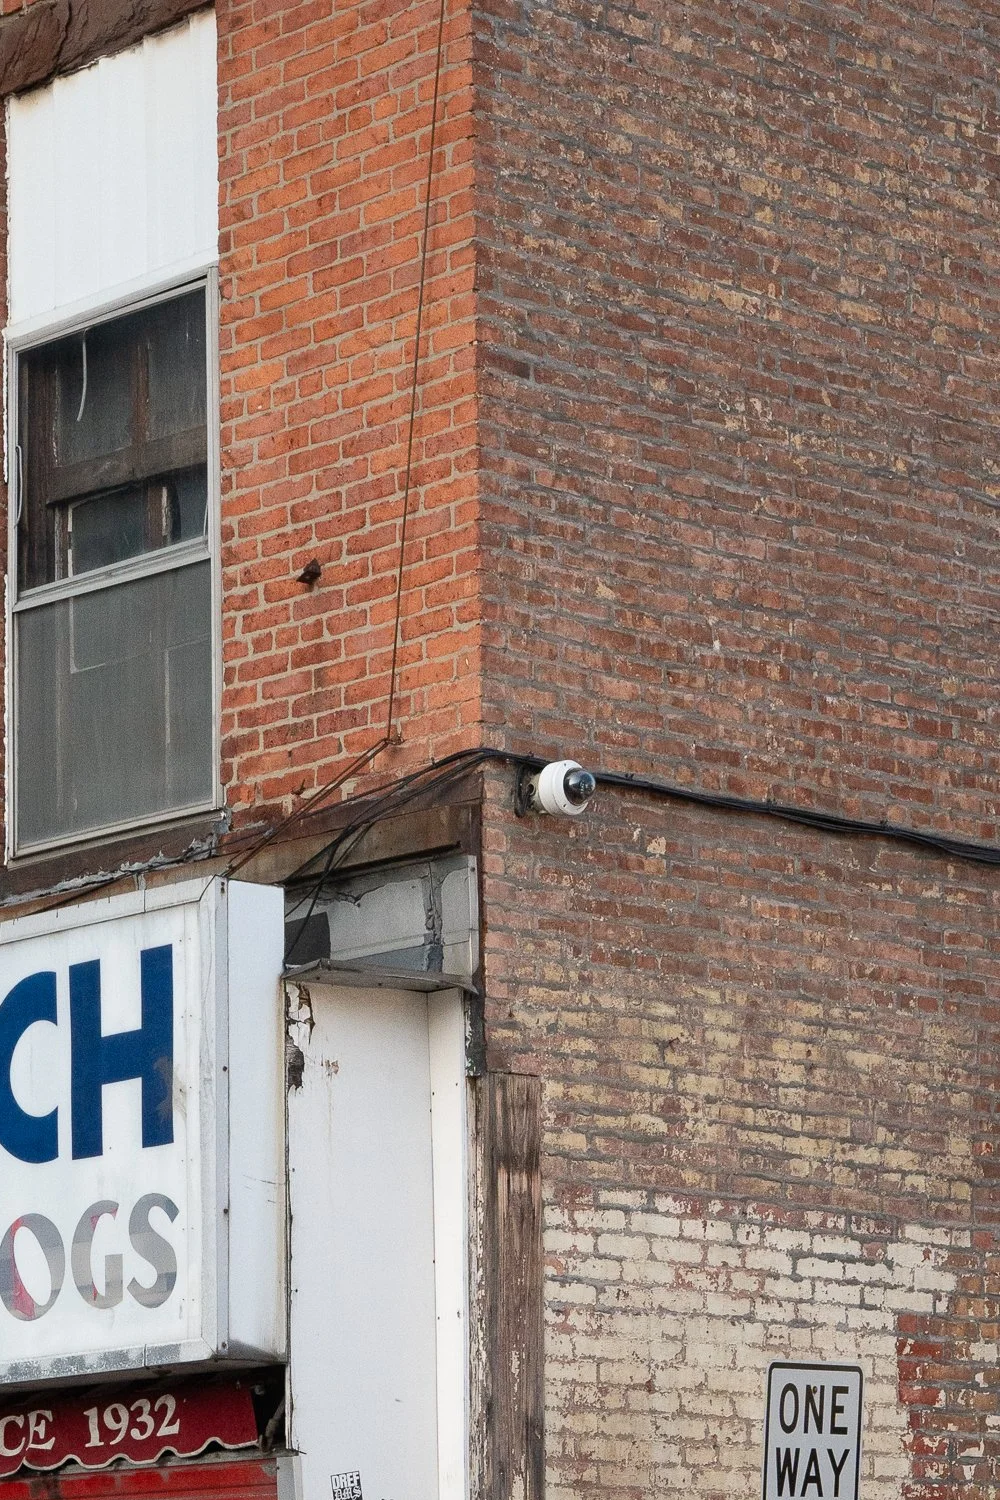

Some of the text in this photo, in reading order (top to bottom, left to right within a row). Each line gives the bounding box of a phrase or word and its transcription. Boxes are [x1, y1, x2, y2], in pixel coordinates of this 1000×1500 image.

[83, 1394, 181, 1448] 1932
[779, 1383, 849, 1435] ONE
[776, 1447, 850, 1498] WAY
